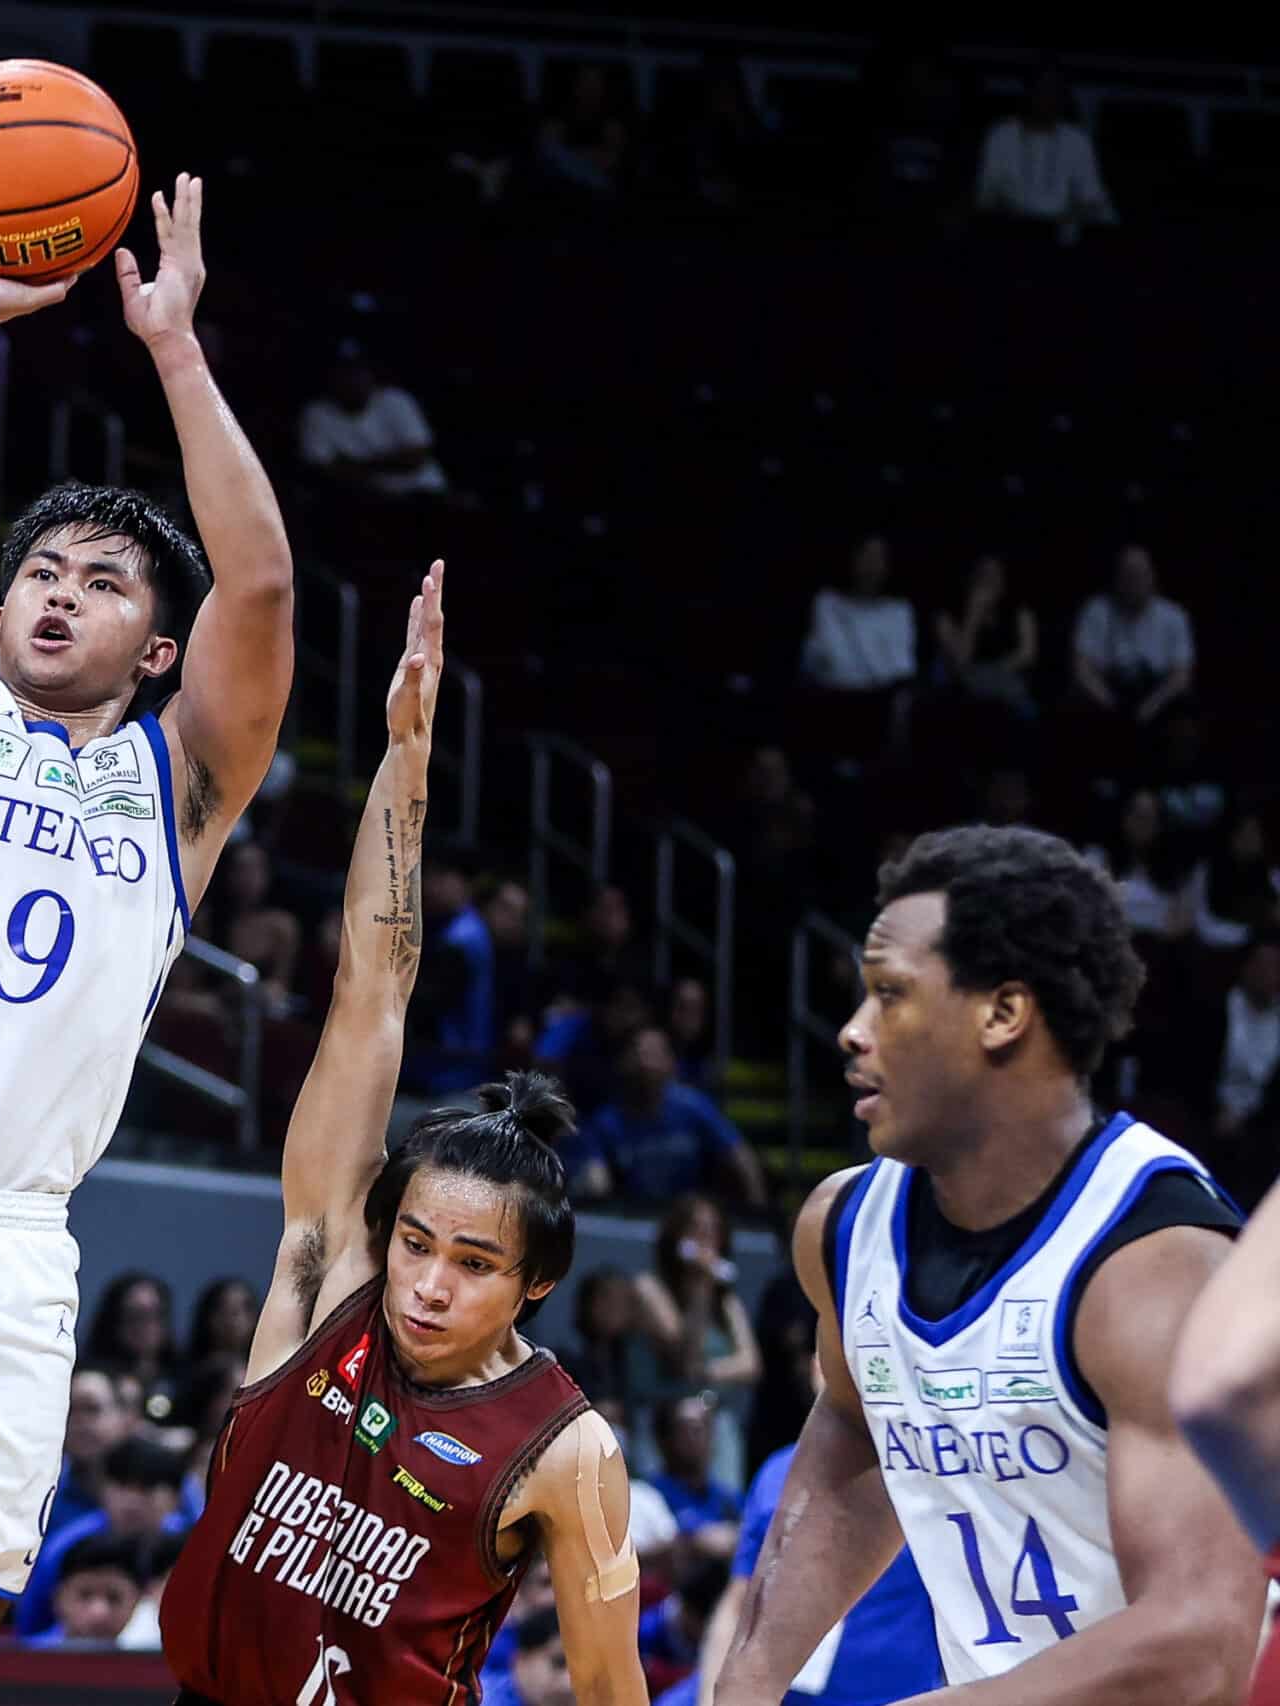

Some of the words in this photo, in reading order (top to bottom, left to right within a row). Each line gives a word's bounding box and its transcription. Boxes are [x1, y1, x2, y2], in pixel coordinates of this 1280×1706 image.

[321, 1386, 354, 1424] BPI
[420, 1432, 480, 1464] CHAMPION
[947, 1512, 1079, 1646] 14
